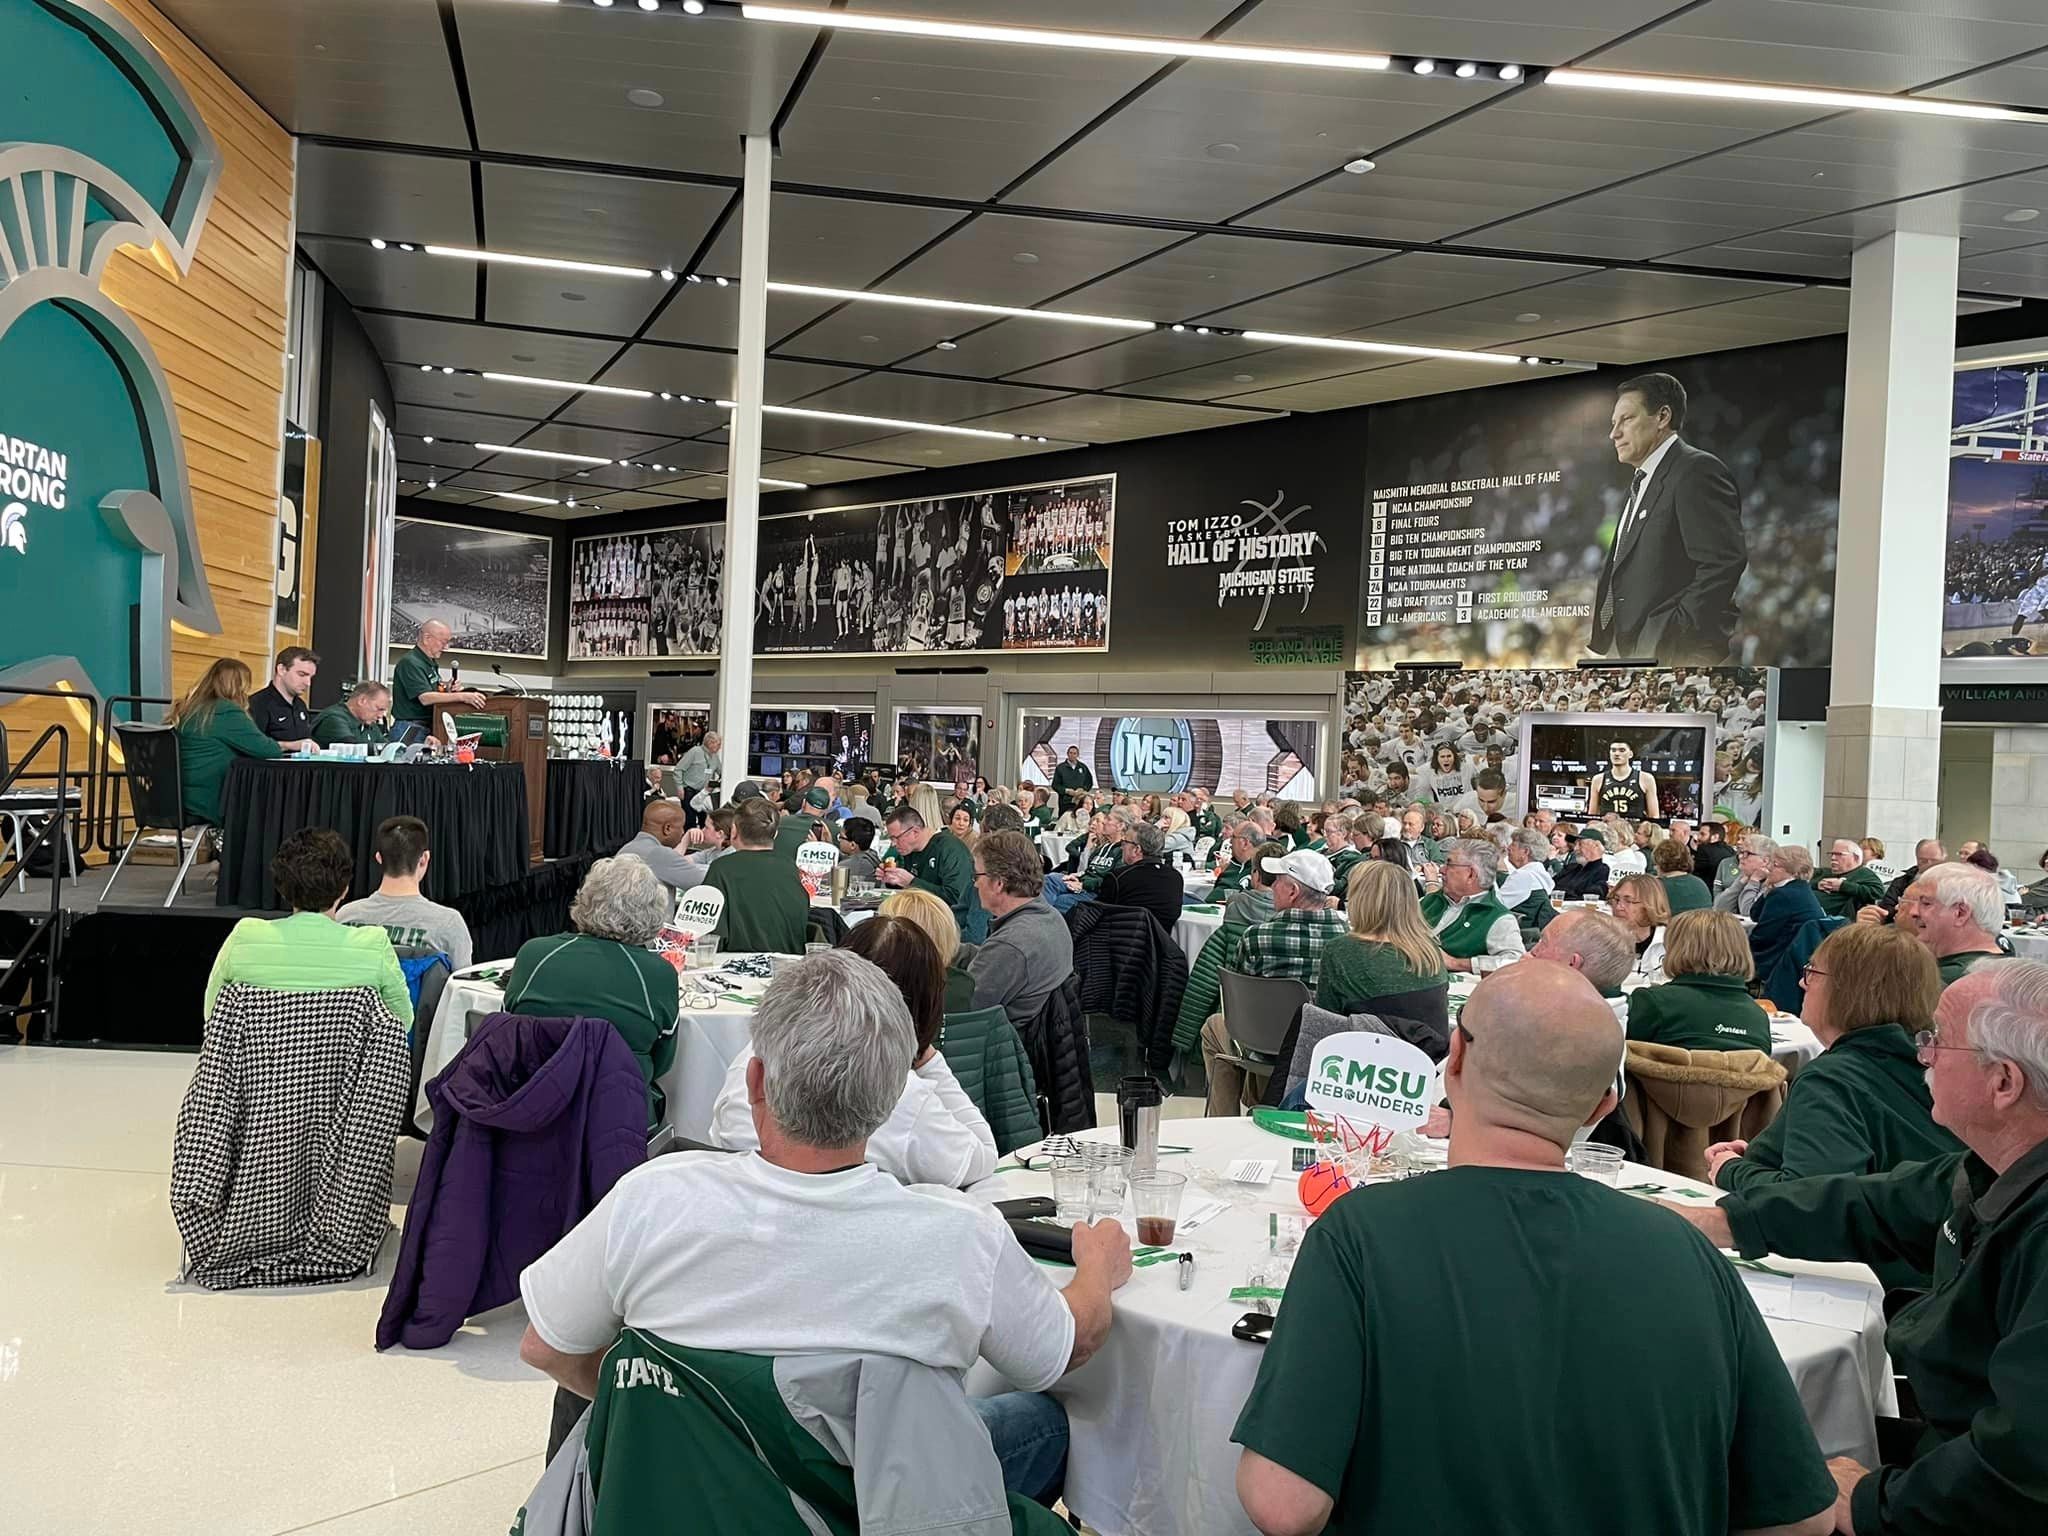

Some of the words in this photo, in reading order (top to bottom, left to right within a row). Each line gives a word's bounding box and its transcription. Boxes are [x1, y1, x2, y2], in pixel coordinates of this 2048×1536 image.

[2017, 452, 2041, 461] State
[1374, 488, 1408, 500] NAISMITH
[1410, 484, 1449, 497] MEMORIAL
[1451, 478, 1500, 492] BASKETBALL
[1502, 476, 1523, 487] HALL
[1525, 474, 1535, 485] OF
[1538, 470, 1561, 483] FAME
[1392, 502, 1413, 514] NCAA
[1414, 497, 1473, 512] CHAMPIONSHIP
[1168, 519, 1198, 533] TOM
[1205, 515, 1242, 529] IZZO
[1391, 518, 1412, 530] FINAL
[1414, 516, 1439, 528] FOURS
[1168, 528, 1260, 543] BASKETBALL
[1390, 533, 1403, 545] BIG
[1404, 533, 1420, 544] TEN
[1422, 528, 1485, 543] CHAMPIONSHIPS
[1168, 541, 1208, 566] HALL
[1213, 537, 1235, 563] OF
[1239, 531, 1317, 561] HISTORY
[1389, 550, 1402, 561] BIG
[1404, 549, 1419, 560] TEN
[1420, 545, 1472, 559] TOURNAMENT
[1474, 540, 1541, 556] CHAMPIONSHIPS
[1389, 566, 1406, 577] TIME
[1408, 562, 1445, 575] NATIONAL
[1447, 561, 1474, 573] COACH
[1476, 560, 1487, 571] OF
[1488, 559, 1504, 570] THE
[1506, 558, 1528, 569] YEAR
[1219, 570, 1276, 588] MICHIGAN
[1278, 567, 1315, 585] STATE
[1388, 582, 1409, 592] NCAA
[1410, 578, 1466, 591] TOURNAMENTS
[1220, 584, 1314, 597] UNIVERSITY
[1478, 592, 1501, 604] FIRST
[1503, 590, 1548, 602] ROUNDERS
[1387, 597, 1402, 608] NBA
[1403, 596, 1428, 607] DRAFT
[1430, 595, 1453, 606] PICKS
[1386, 611, 1446, 624] ALL-AMERICANS
[1478, 608, 1519, 620] ACADEMIC
[1522, 605, 1590, 618] ALL-AMERICANS
[1254, 653, 1342, 665] SKANDALARIS
[1946, 689, 2010, 700] WILLIAM
[1122, 732, 1189, 776] MSU
[1602, 786, 1639, 801] PURDUE
[1613, 800, 1628, 813] 15
[810, 850, 836, 860] MSU
[691, 900, 720, 917] MSU
[1346, 1060, 1426, 1099] MSU
[1311, 1081, 1425, 1117] REBOUNDERS
[614, 1357, 679, 1397] TATE
